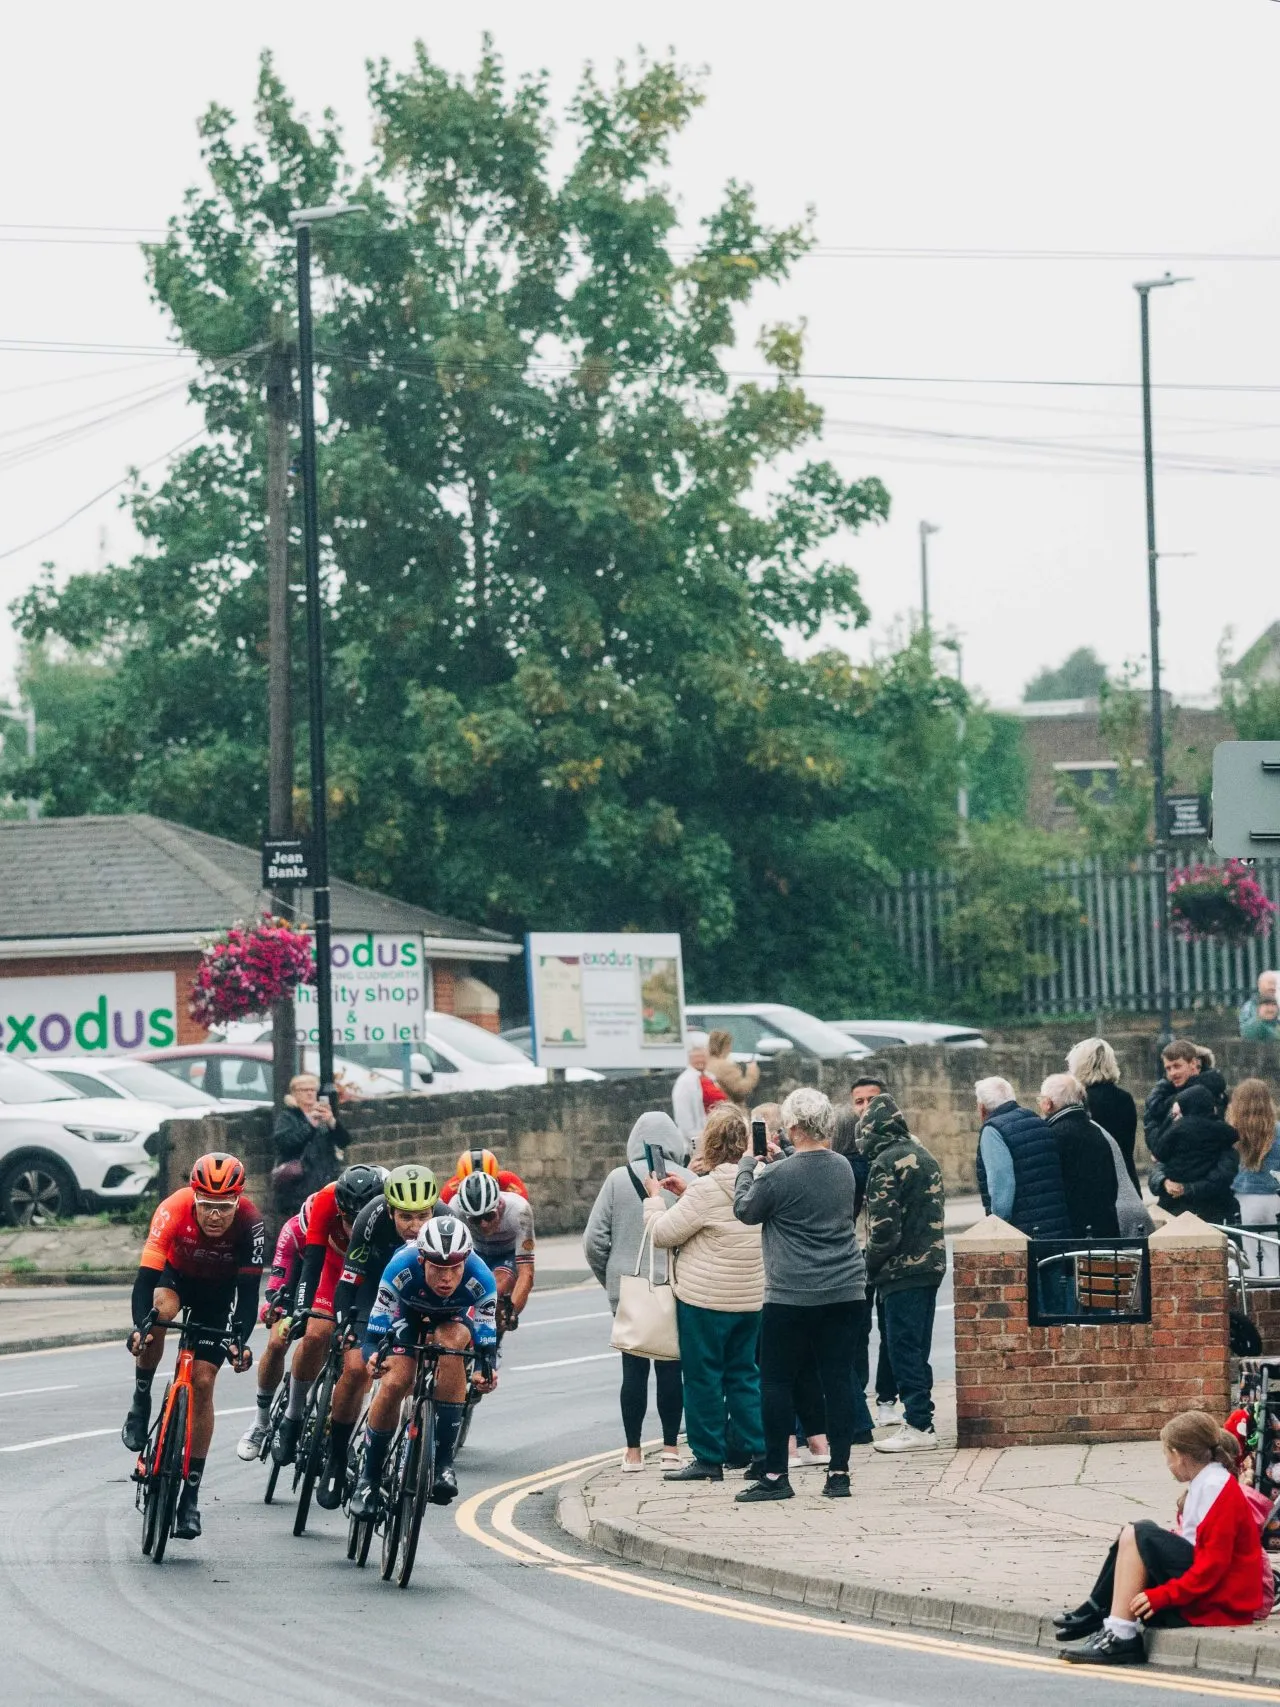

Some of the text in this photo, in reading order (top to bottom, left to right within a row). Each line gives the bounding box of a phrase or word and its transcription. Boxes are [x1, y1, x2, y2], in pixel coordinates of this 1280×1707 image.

[271, 851, 303, 864] Jean
[268, 865, 308, 879] Banks
[583, 949, 633, 966] exodus
[365, 984, 419, 1005] shop
[347, 1010, 357, 1023] &
[364, 1024, 384, 1041] to
[393, 1023, 419, 1041] let
[251, 1221, 265, 1265] INEOS
